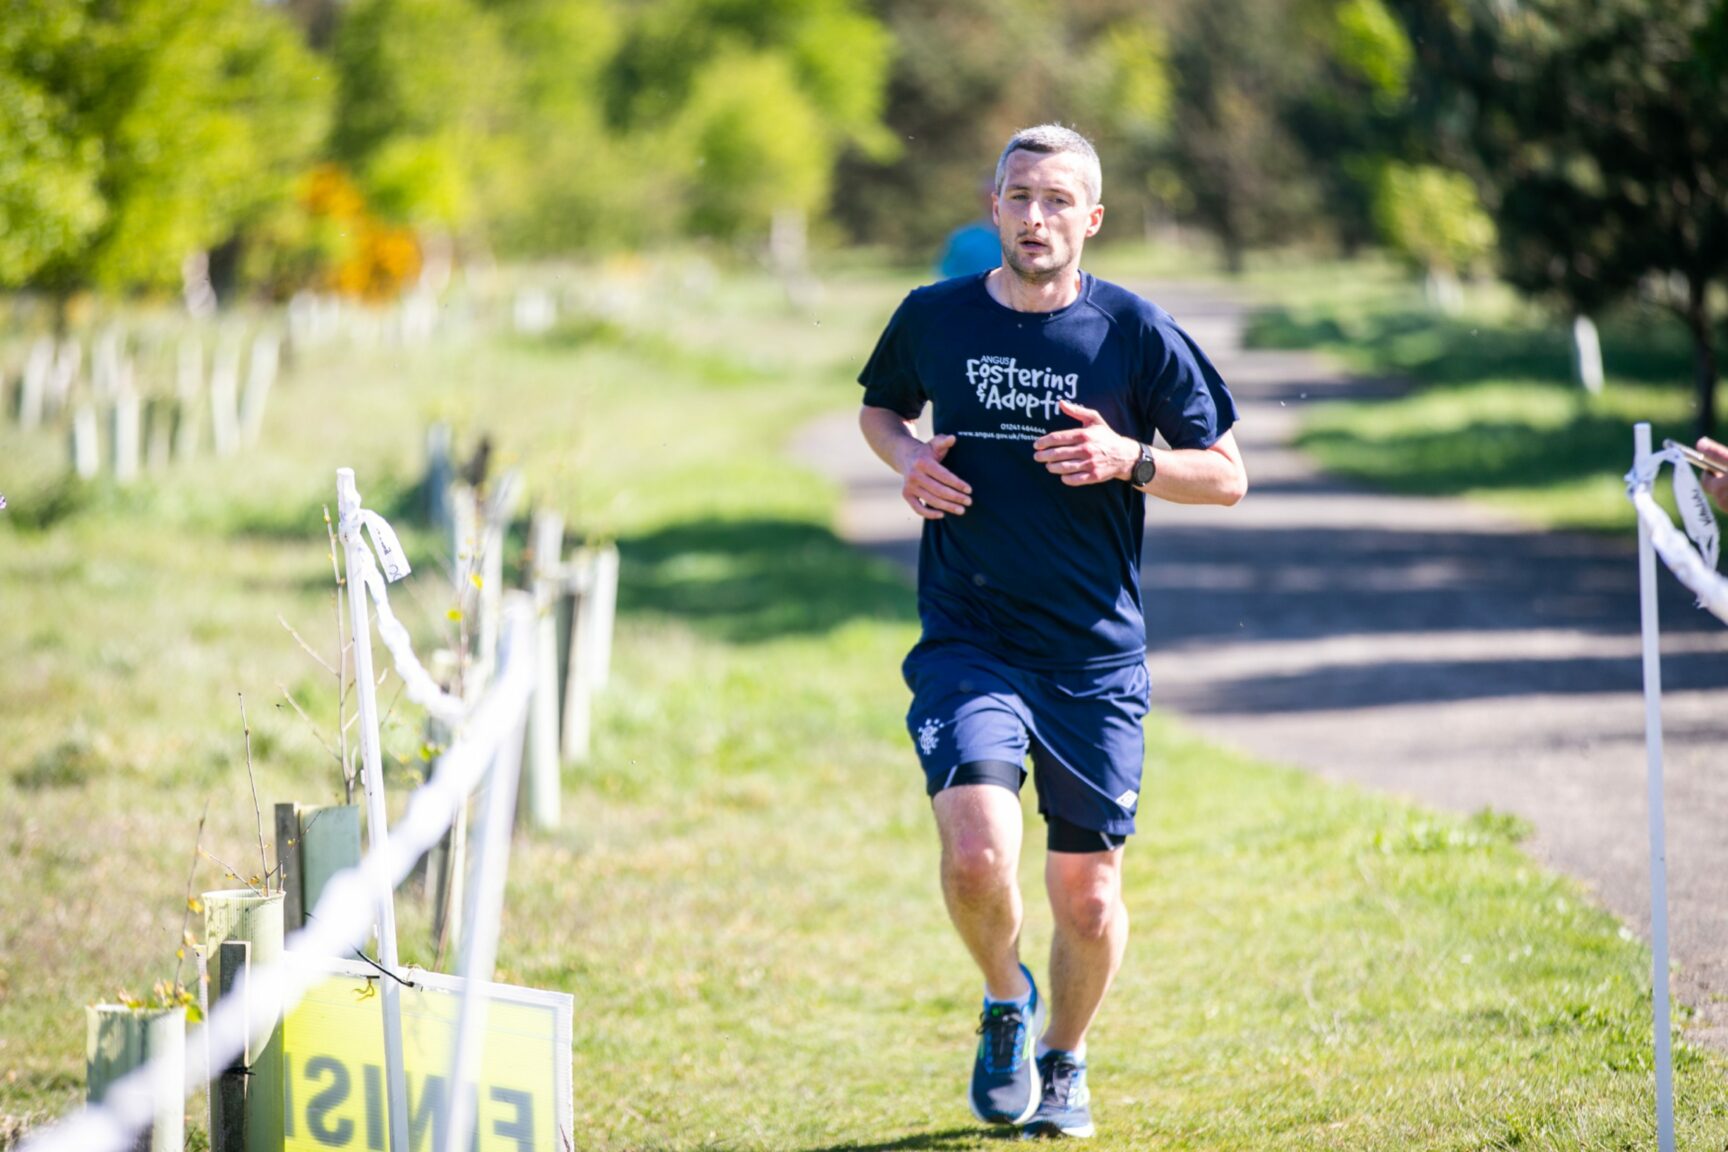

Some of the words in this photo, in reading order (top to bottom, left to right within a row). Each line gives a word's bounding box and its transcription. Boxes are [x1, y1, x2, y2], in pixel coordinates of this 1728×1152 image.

[980, 355, 1010, 365] ANGUS
[965, 358, 1079, 399] Fostering
[985, 384, 1084, 421] Adopti
[1000, 423, 1020, 431] 01241
